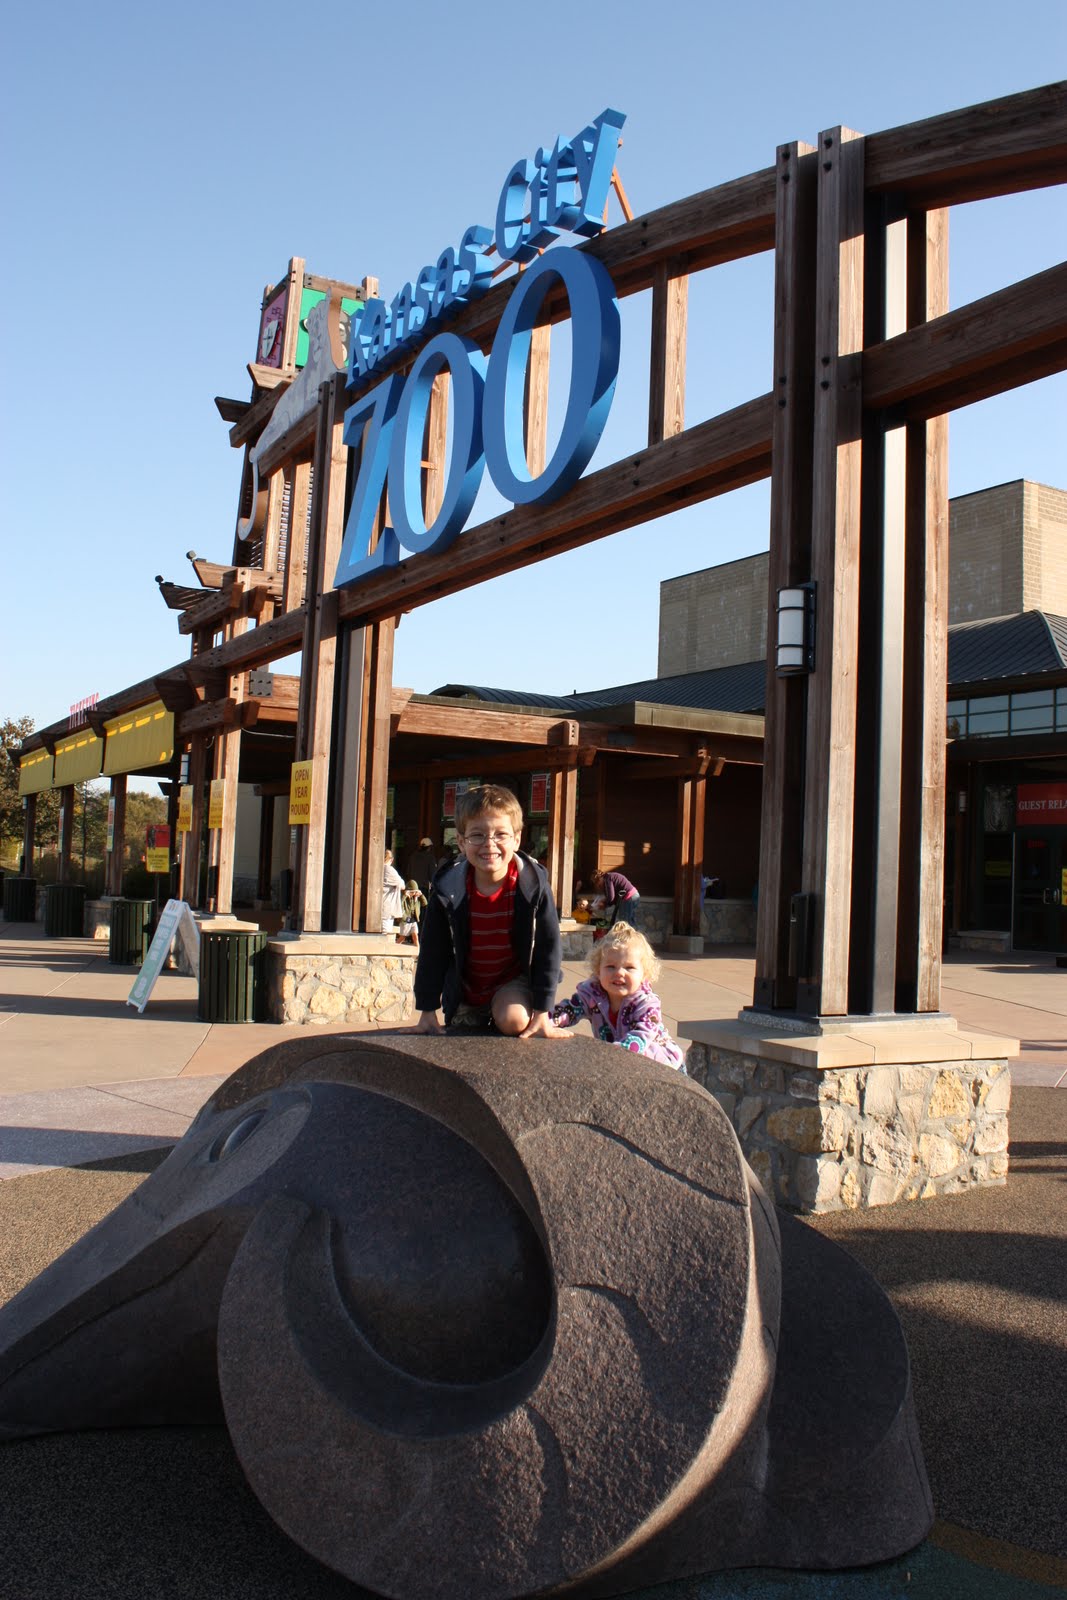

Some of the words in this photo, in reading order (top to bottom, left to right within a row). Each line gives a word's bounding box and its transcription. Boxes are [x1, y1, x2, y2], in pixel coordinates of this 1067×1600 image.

[496, 108, 627, 263] City
[334, 246, 620, 588] ZOO
[295, 769, 309, 781] OPEN
[294, 786, 308, 798] YEAR
[291, 804, 310, 815] ROUND
[1019, 800, 1047, 810] GUEST
